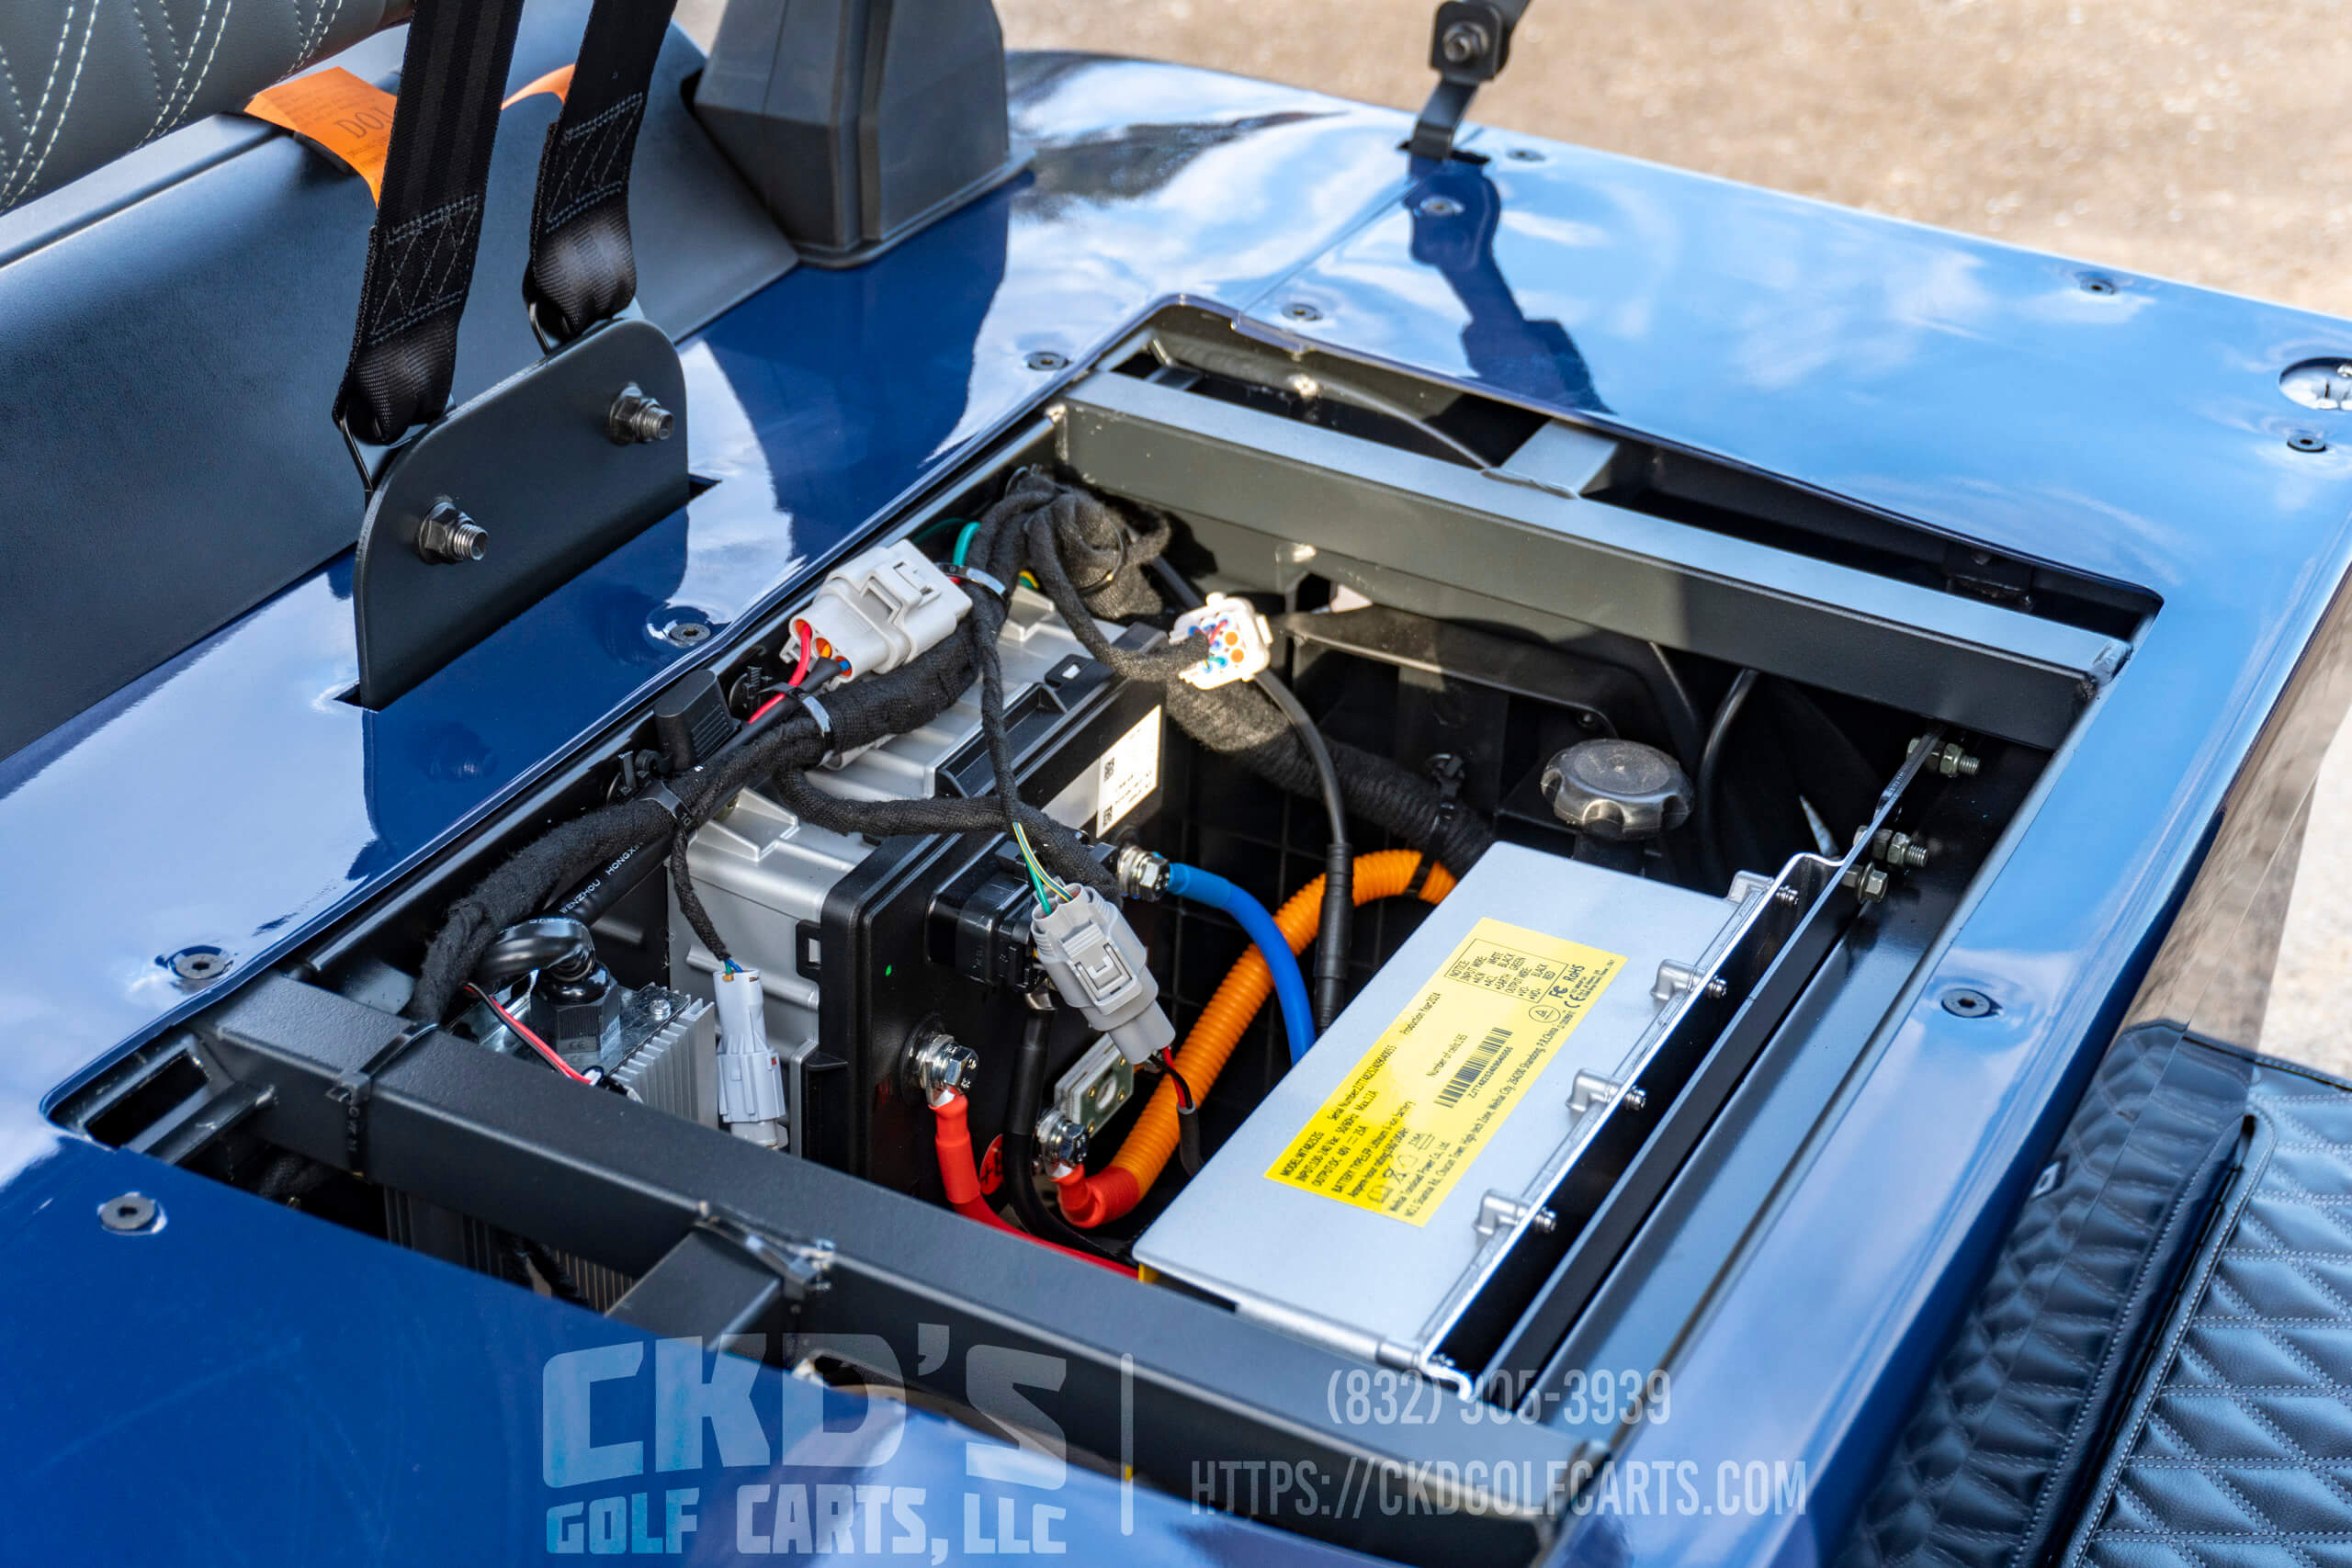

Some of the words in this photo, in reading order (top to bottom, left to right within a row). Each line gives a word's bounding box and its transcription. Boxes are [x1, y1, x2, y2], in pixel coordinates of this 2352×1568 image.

[559, 878, 601, 914] WENZHOU
[1496, 953, 1516, 968] BLACK
[1507, 955, 1527, 971] GREEN
[1459, 966, 1477, 981] INPUT
[1530, 963, 1549, 977] BLACK
[1561, 963, 1586, 982] RoHS
[1398, 1010, 1427, 1035] Production
[1424, 1056, 1448, 1077] Number
